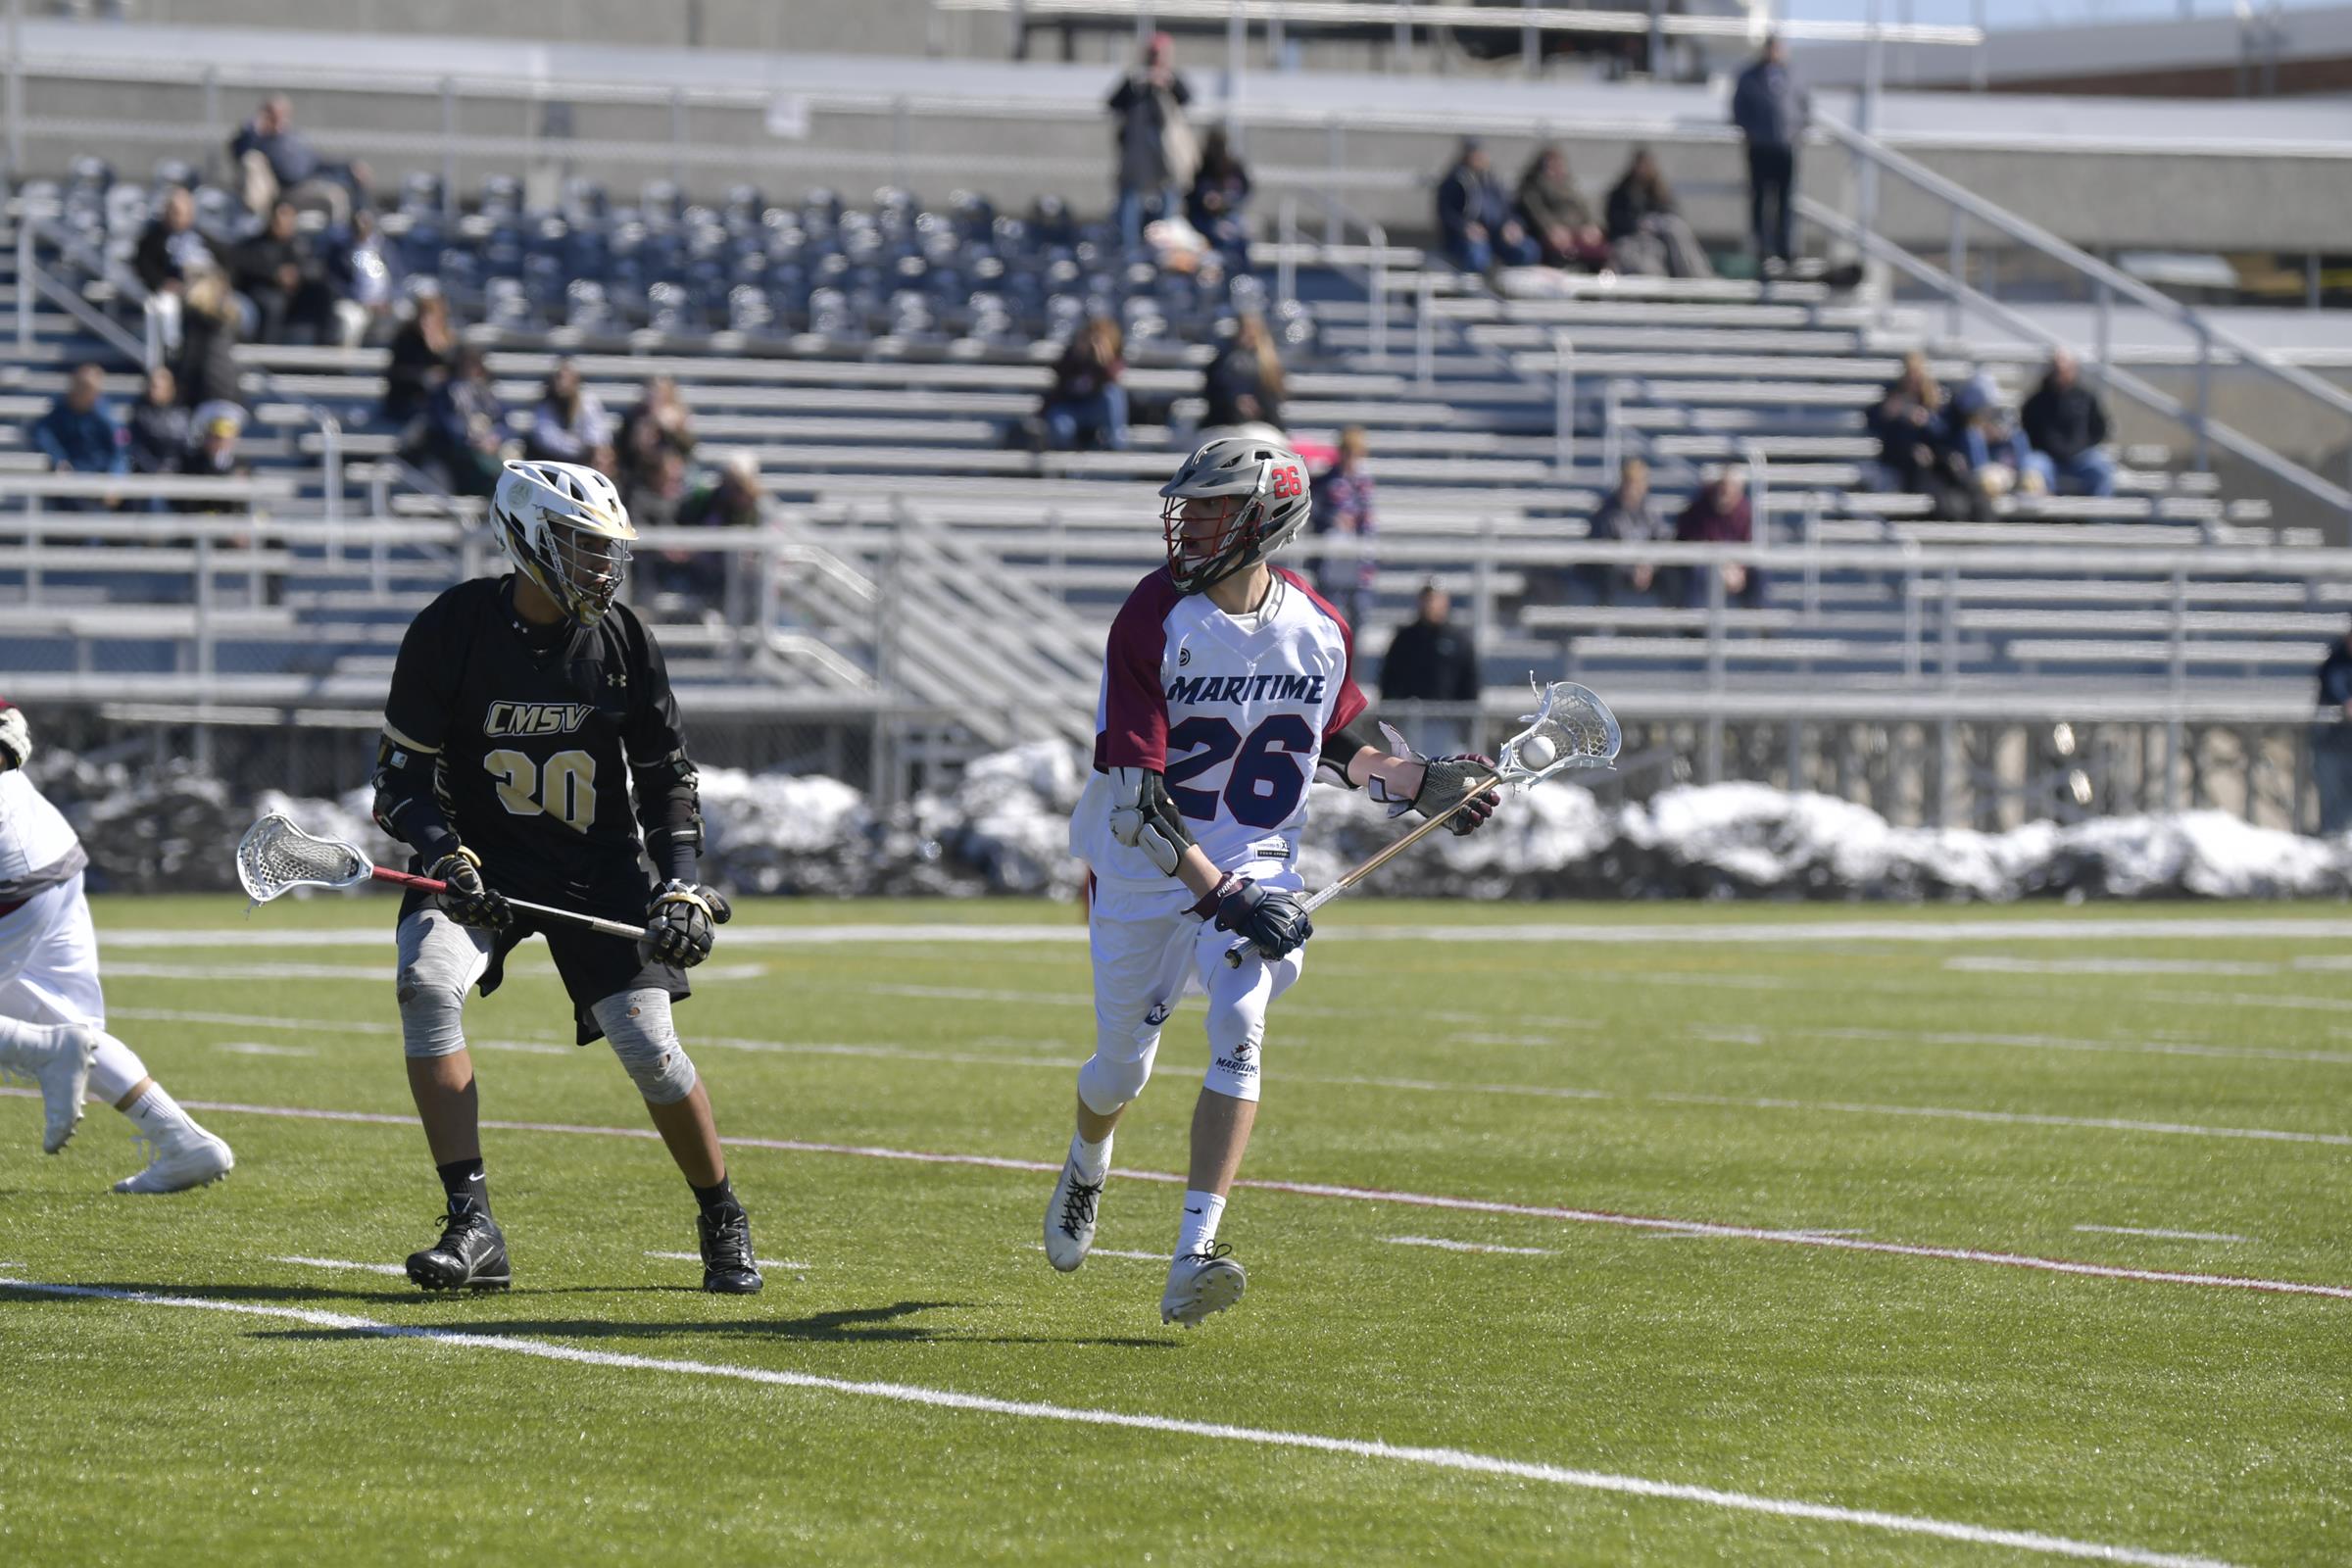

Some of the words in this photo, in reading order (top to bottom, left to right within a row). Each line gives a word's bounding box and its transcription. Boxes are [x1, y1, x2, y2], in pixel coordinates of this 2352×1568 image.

[1271, 466, 1302, 499] 26
[1166, 674, 1326, 705] MARITIME
[485, 701, 594, 737] CMSV
[1166, 714, 1315, 829] 26
